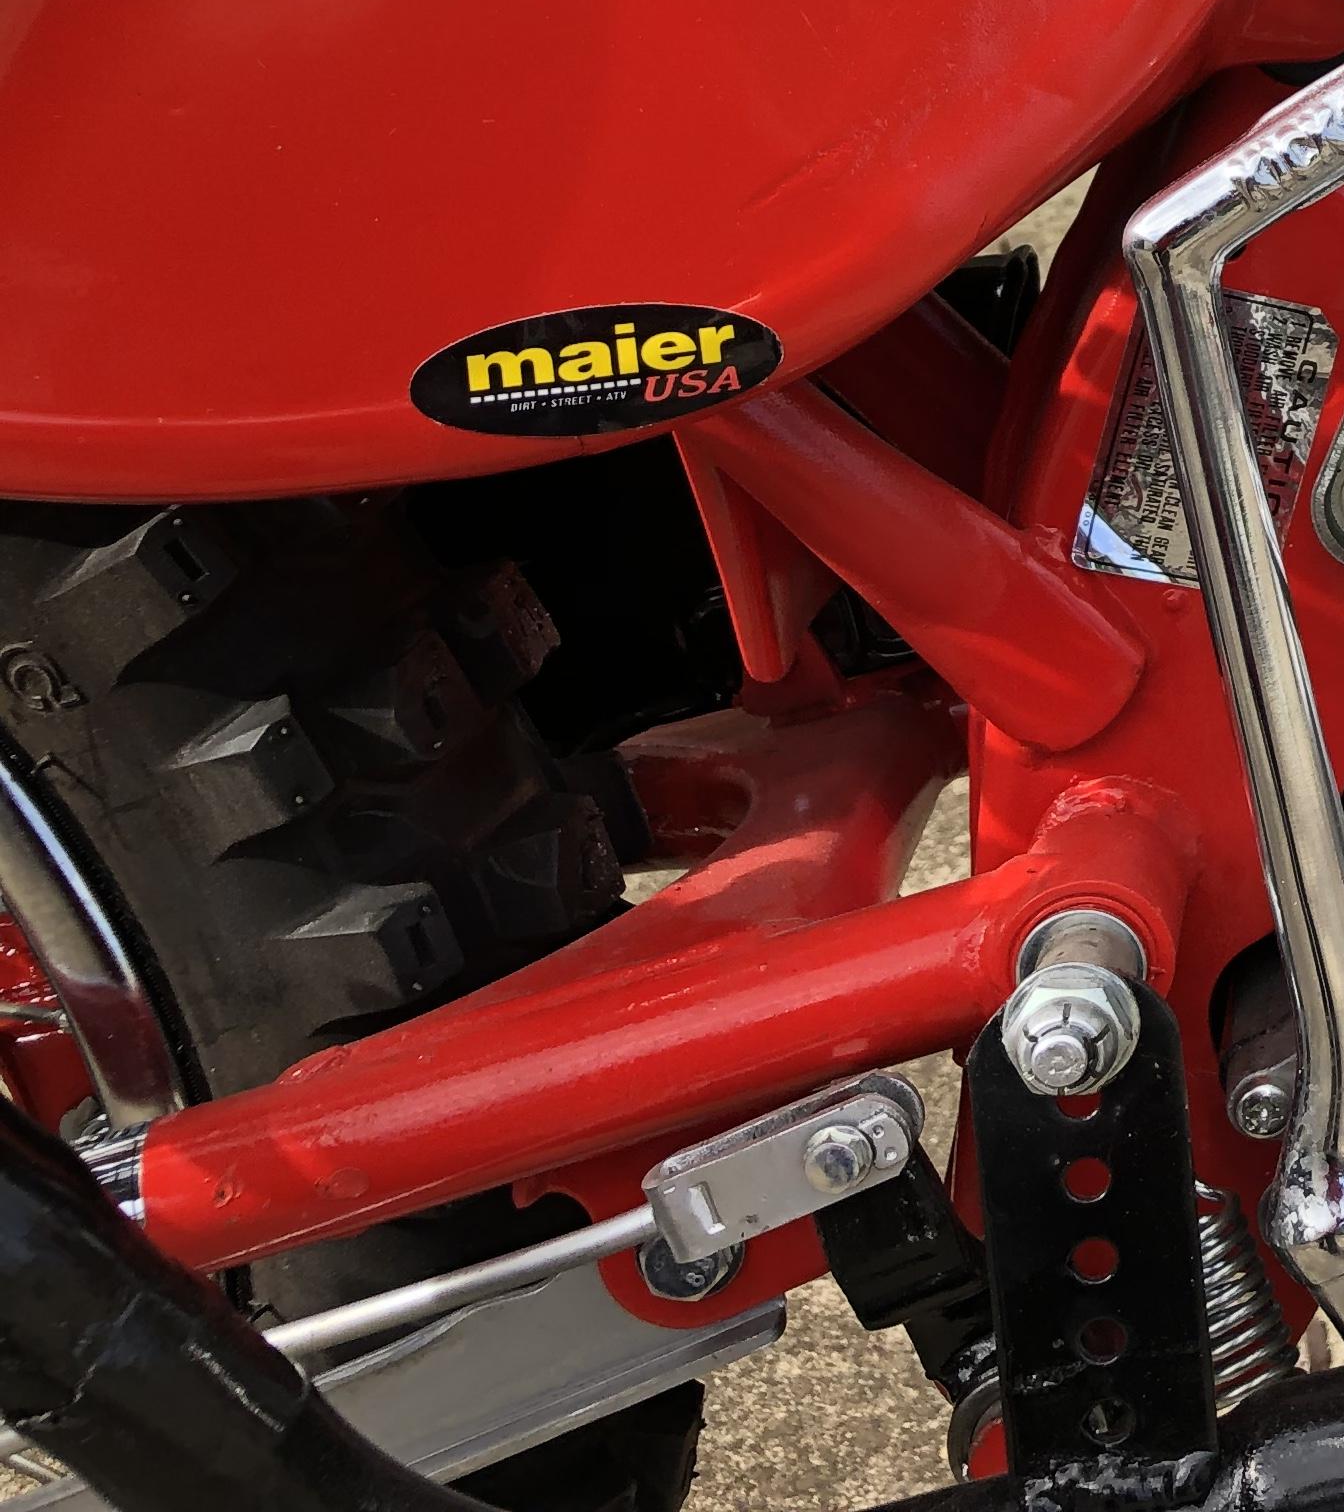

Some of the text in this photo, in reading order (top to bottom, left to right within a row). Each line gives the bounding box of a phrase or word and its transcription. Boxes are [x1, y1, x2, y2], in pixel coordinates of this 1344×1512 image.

[466, 322, 735, 393] maier
[1261, 332, 1283, 365] WASH
[1276, 335, 1302, 382] REMOVE
[510, 390, 627, 413] DIRT STREET ATV
[644, 366, 742, 403] USA
[1269, 390, 1288, 409] AIR
[1157, 495, 1181, 531] CLEAN
